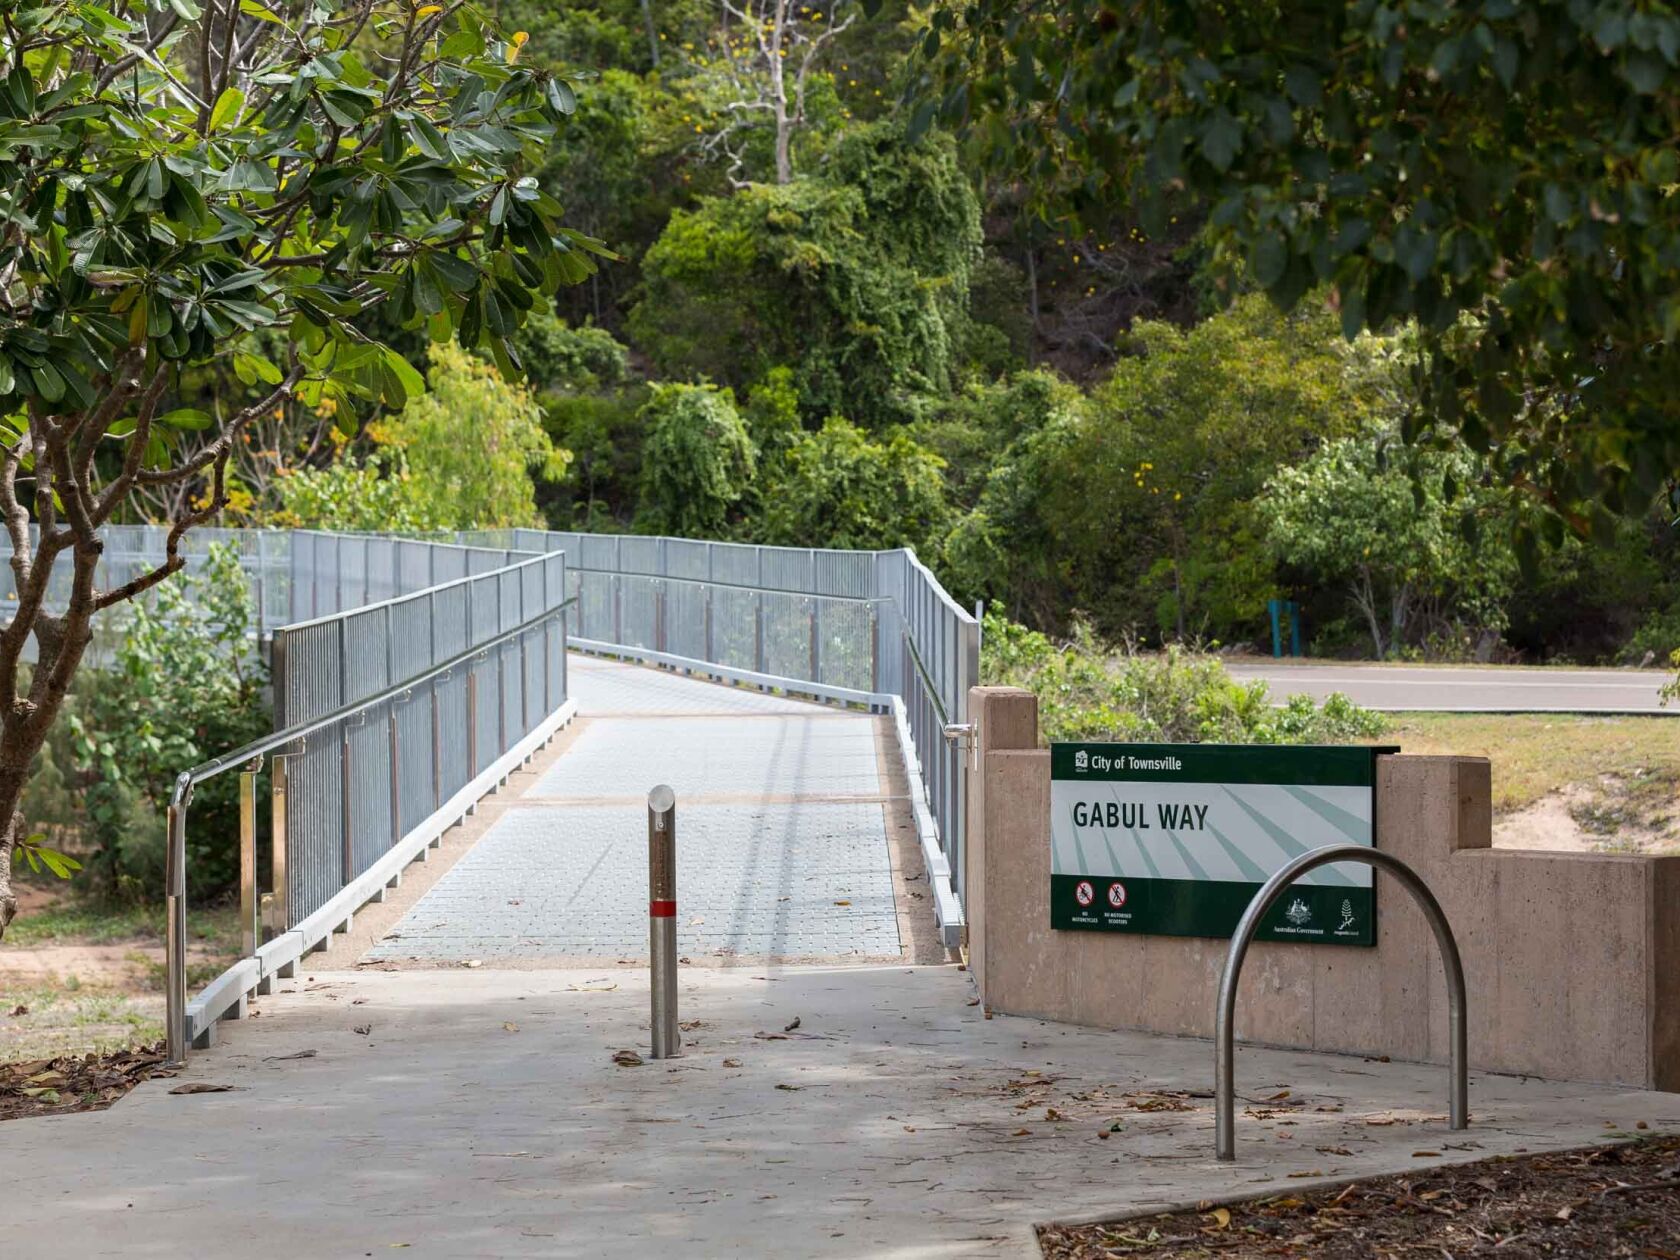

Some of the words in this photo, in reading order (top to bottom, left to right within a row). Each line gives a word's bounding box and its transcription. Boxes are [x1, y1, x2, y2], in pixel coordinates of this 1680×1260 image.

[1091, 756, 1112, 772] City
[1114, 756, 1126, 769] of
[1128, 757, 1182, 770] Townsville
[1074, 801, 1150, 829] GABUL
[1158, 804, 1208, 830] WAY
